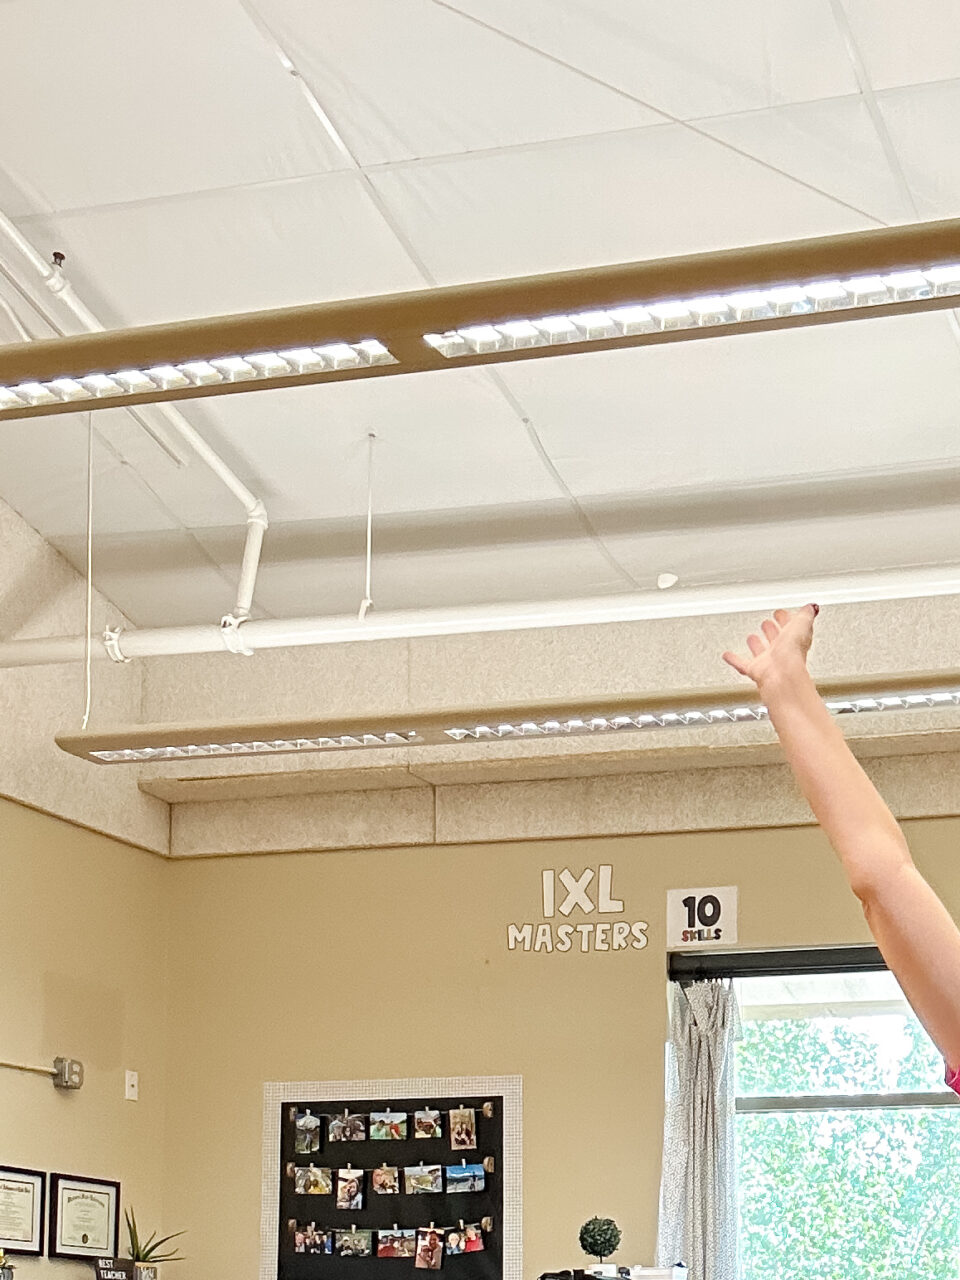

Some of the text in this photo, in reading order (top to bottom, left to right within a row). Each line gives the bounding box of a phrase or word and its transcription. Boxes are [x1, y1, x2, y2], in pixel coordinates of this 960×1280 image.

[541, 864, 625, 918] IXL
[682, 895, 722, 929] 10
[507, 921, 649, 953] MASTERS
[681, 927, 722, 942] SKILLS
